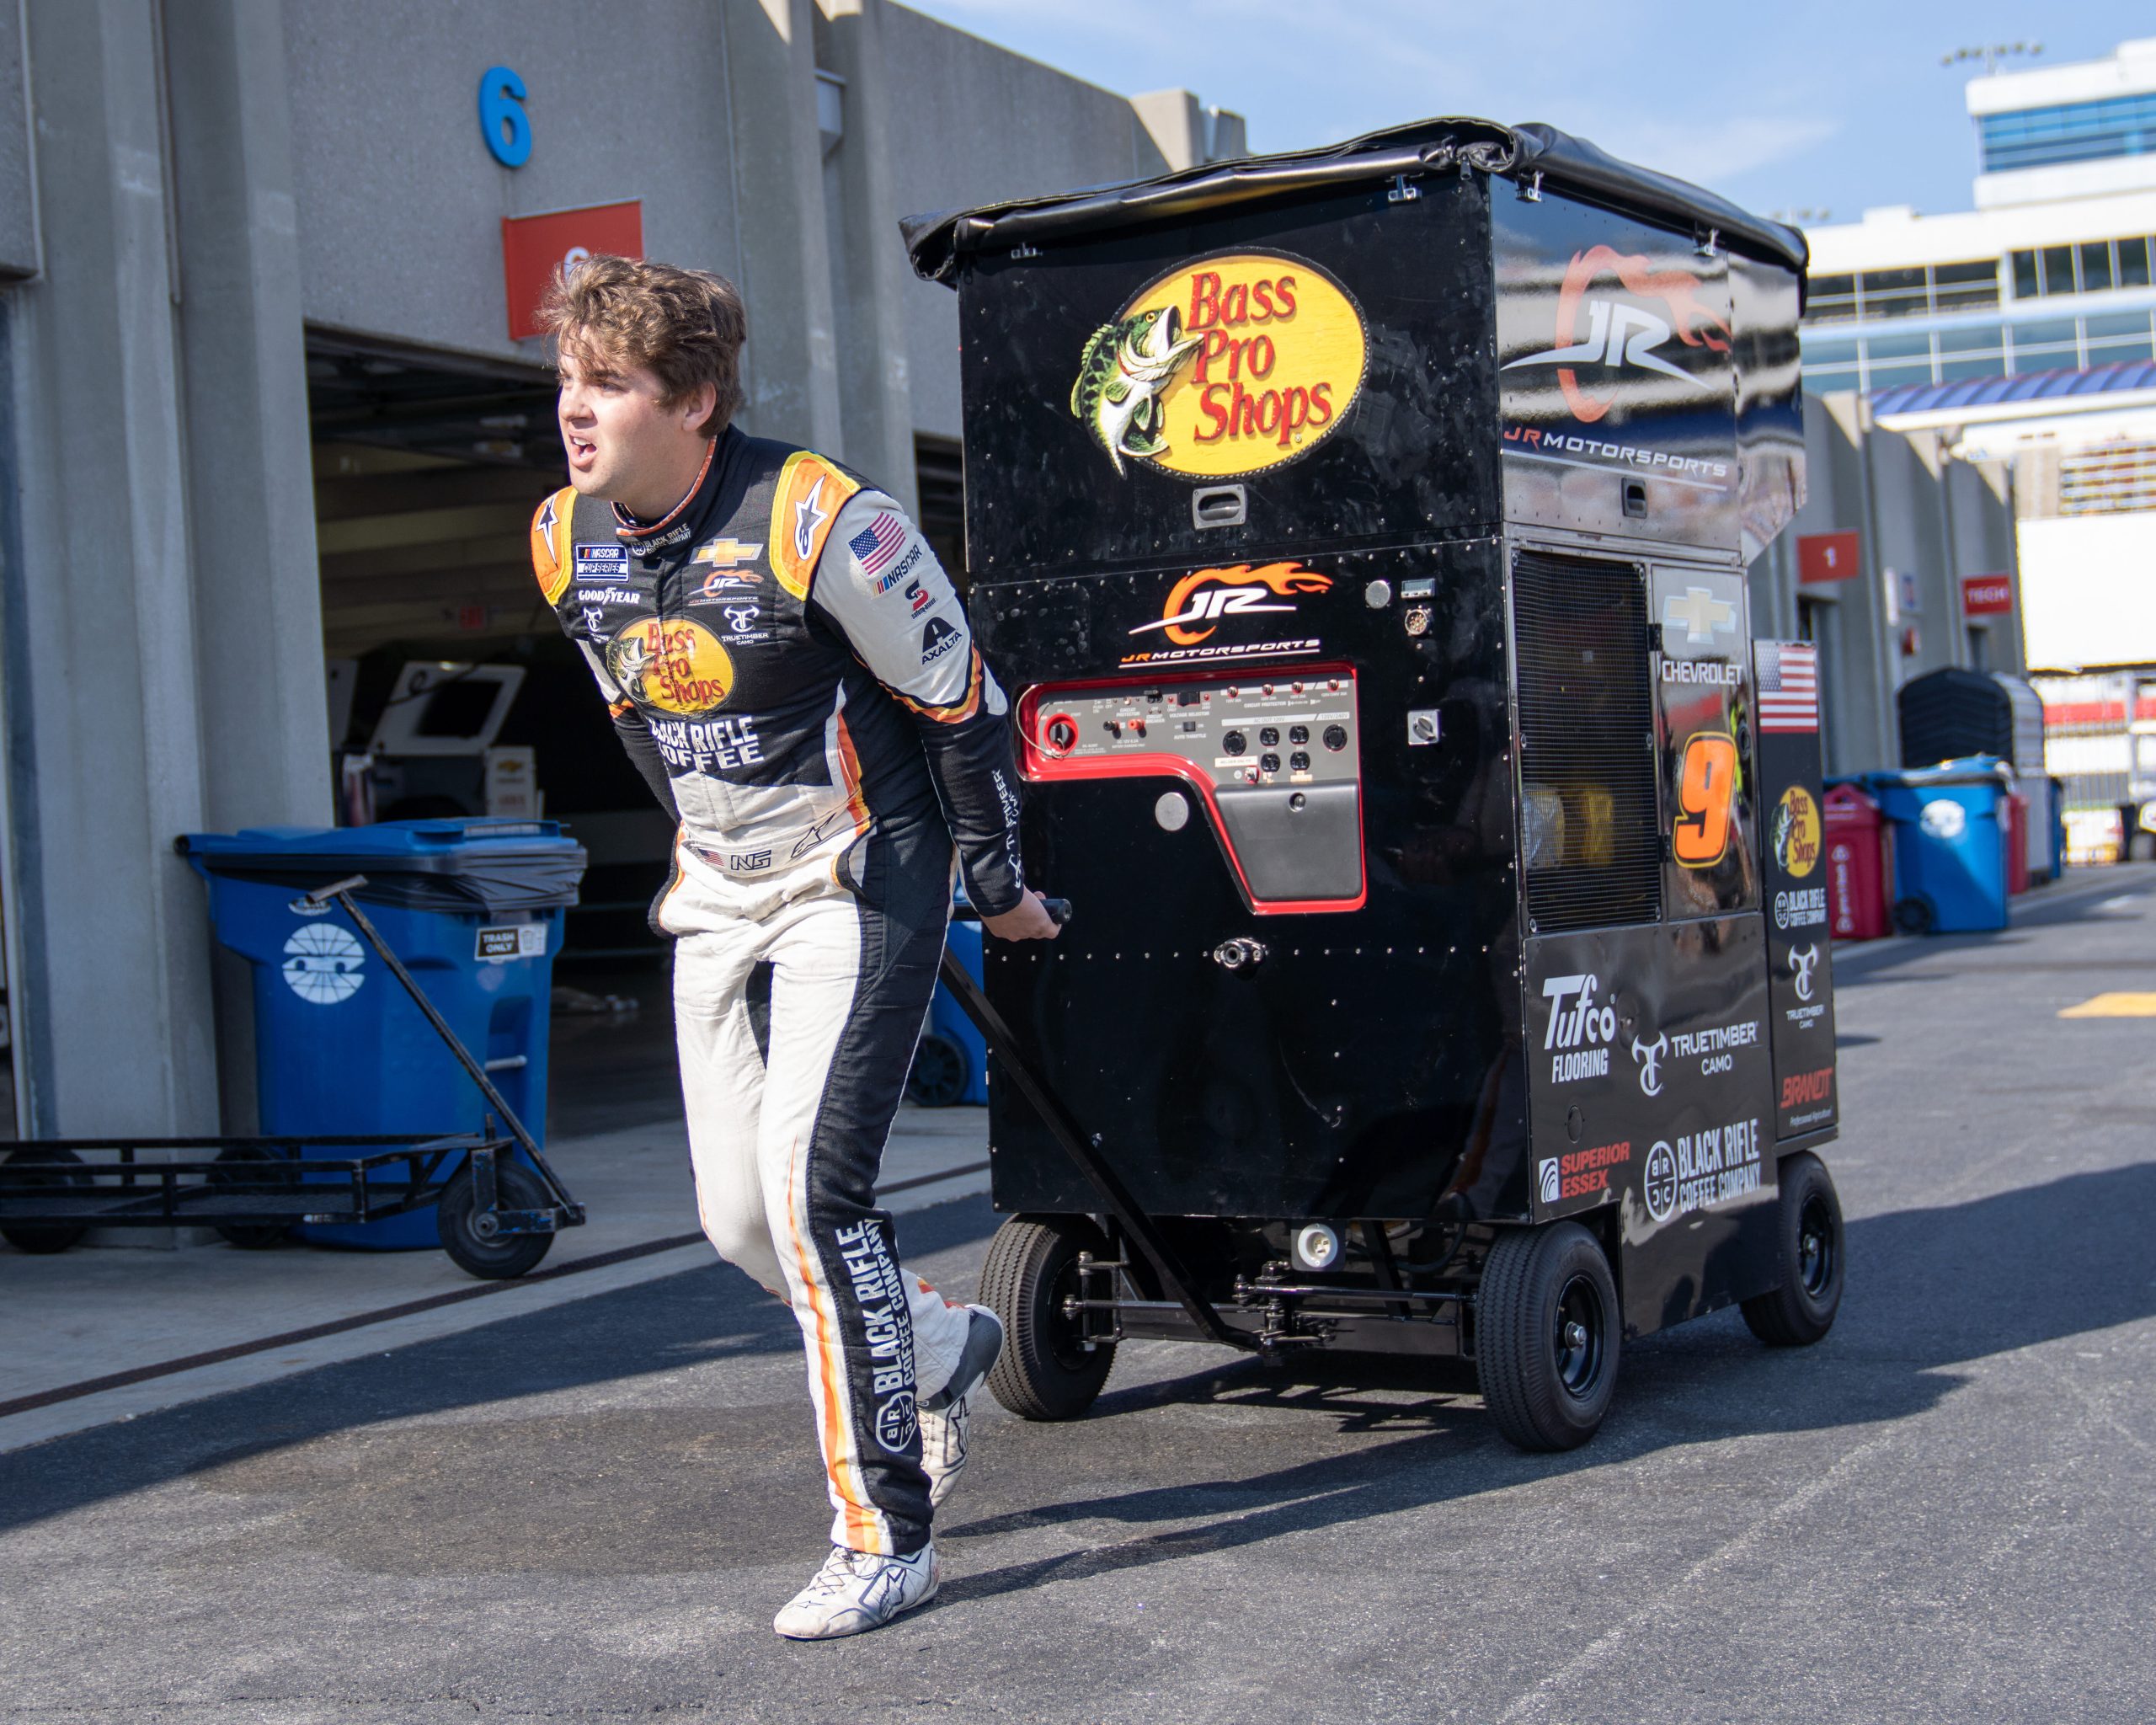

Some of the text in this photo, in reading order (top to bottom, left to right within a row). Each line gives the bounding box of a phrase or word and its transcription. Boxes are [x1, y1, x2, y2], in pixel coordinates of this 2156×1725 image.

[479, 66, 532, 168] 6
[1186, 271, 1297, 331] Bass
[1190, 328, 1275, 384] Pro
[1193, 382, 1334, 446] Shops
[667, 523, 690, 539] RIFLE
[584, 563, 620, 573] CUP SERIES
[592, 548, 619, 558] NASCAR
[887, 544, 922, 587] NASCAR
[1823, 547, 1836, 567] 1
[722, 633, 769, 642] TRUETIMBER
[922, 632, 962, 665] AXALTA
[1662, 660, 1742, 685] CHEVROLET
[690, 717, 758, 752] RIFLE
[1673, 731, 1740, 868] 9
[1790, 790, 1808, 815] Bass
[1792, 838, 1815, 868] Shops
[1789, 889, 1808, 911] BLACK
[1809, 887, 1826, 910] RIFLE
[483, 932, 515, 943] TRASH
[485, 943, 512, 953] ONLY
[1542, 974, 1615, 1050] Tufco
[1785, 1004, 1825, 1021] TRUETIMBER
[1671, 1021, 1758, 1058] TRUETIMBER
[1552, 1048, 1609, 1084] FLOORING
[1701, 1055, 1732, 1076] CAMO
[1780, 1067, 1833, 1108] BRANDT
[1561, 1141, 1630, 1175] SUPERIOR
[1677, 1118, 1761, 1180] BLACK RIFLE
[1561, 1168, 1609, 1198] ESSEX
[1679, 1162, 1762, 1214] COFFEE COMPANY
[835, 1220, 903, 1395] BLACK RIFLE
[863, 1218, 915, 1386] COFFEE COMPANY
